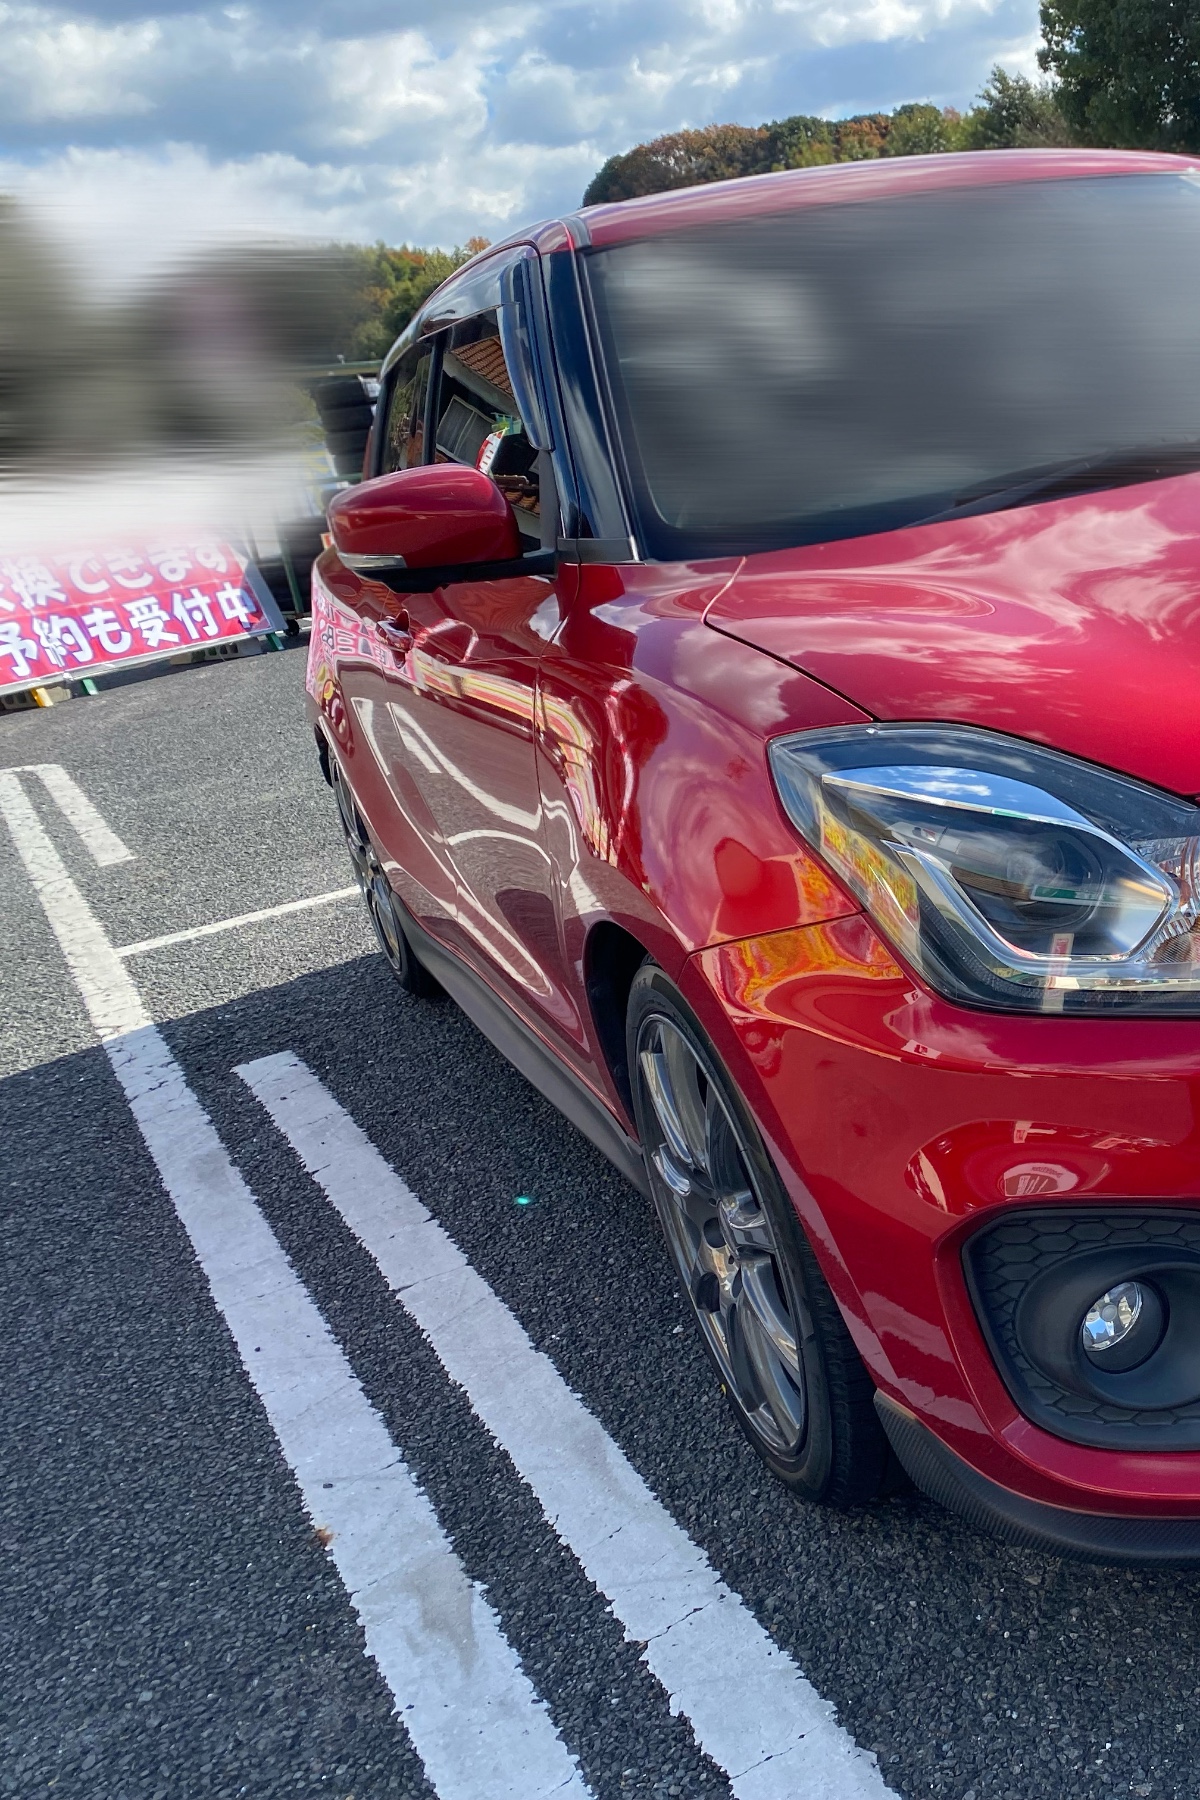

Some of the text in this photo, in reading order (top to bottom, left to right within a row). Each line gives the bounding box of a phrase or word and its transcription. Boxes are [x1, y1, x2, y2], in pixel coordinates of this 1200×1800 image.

[0, 582, 258, 677] 予約も受付中
